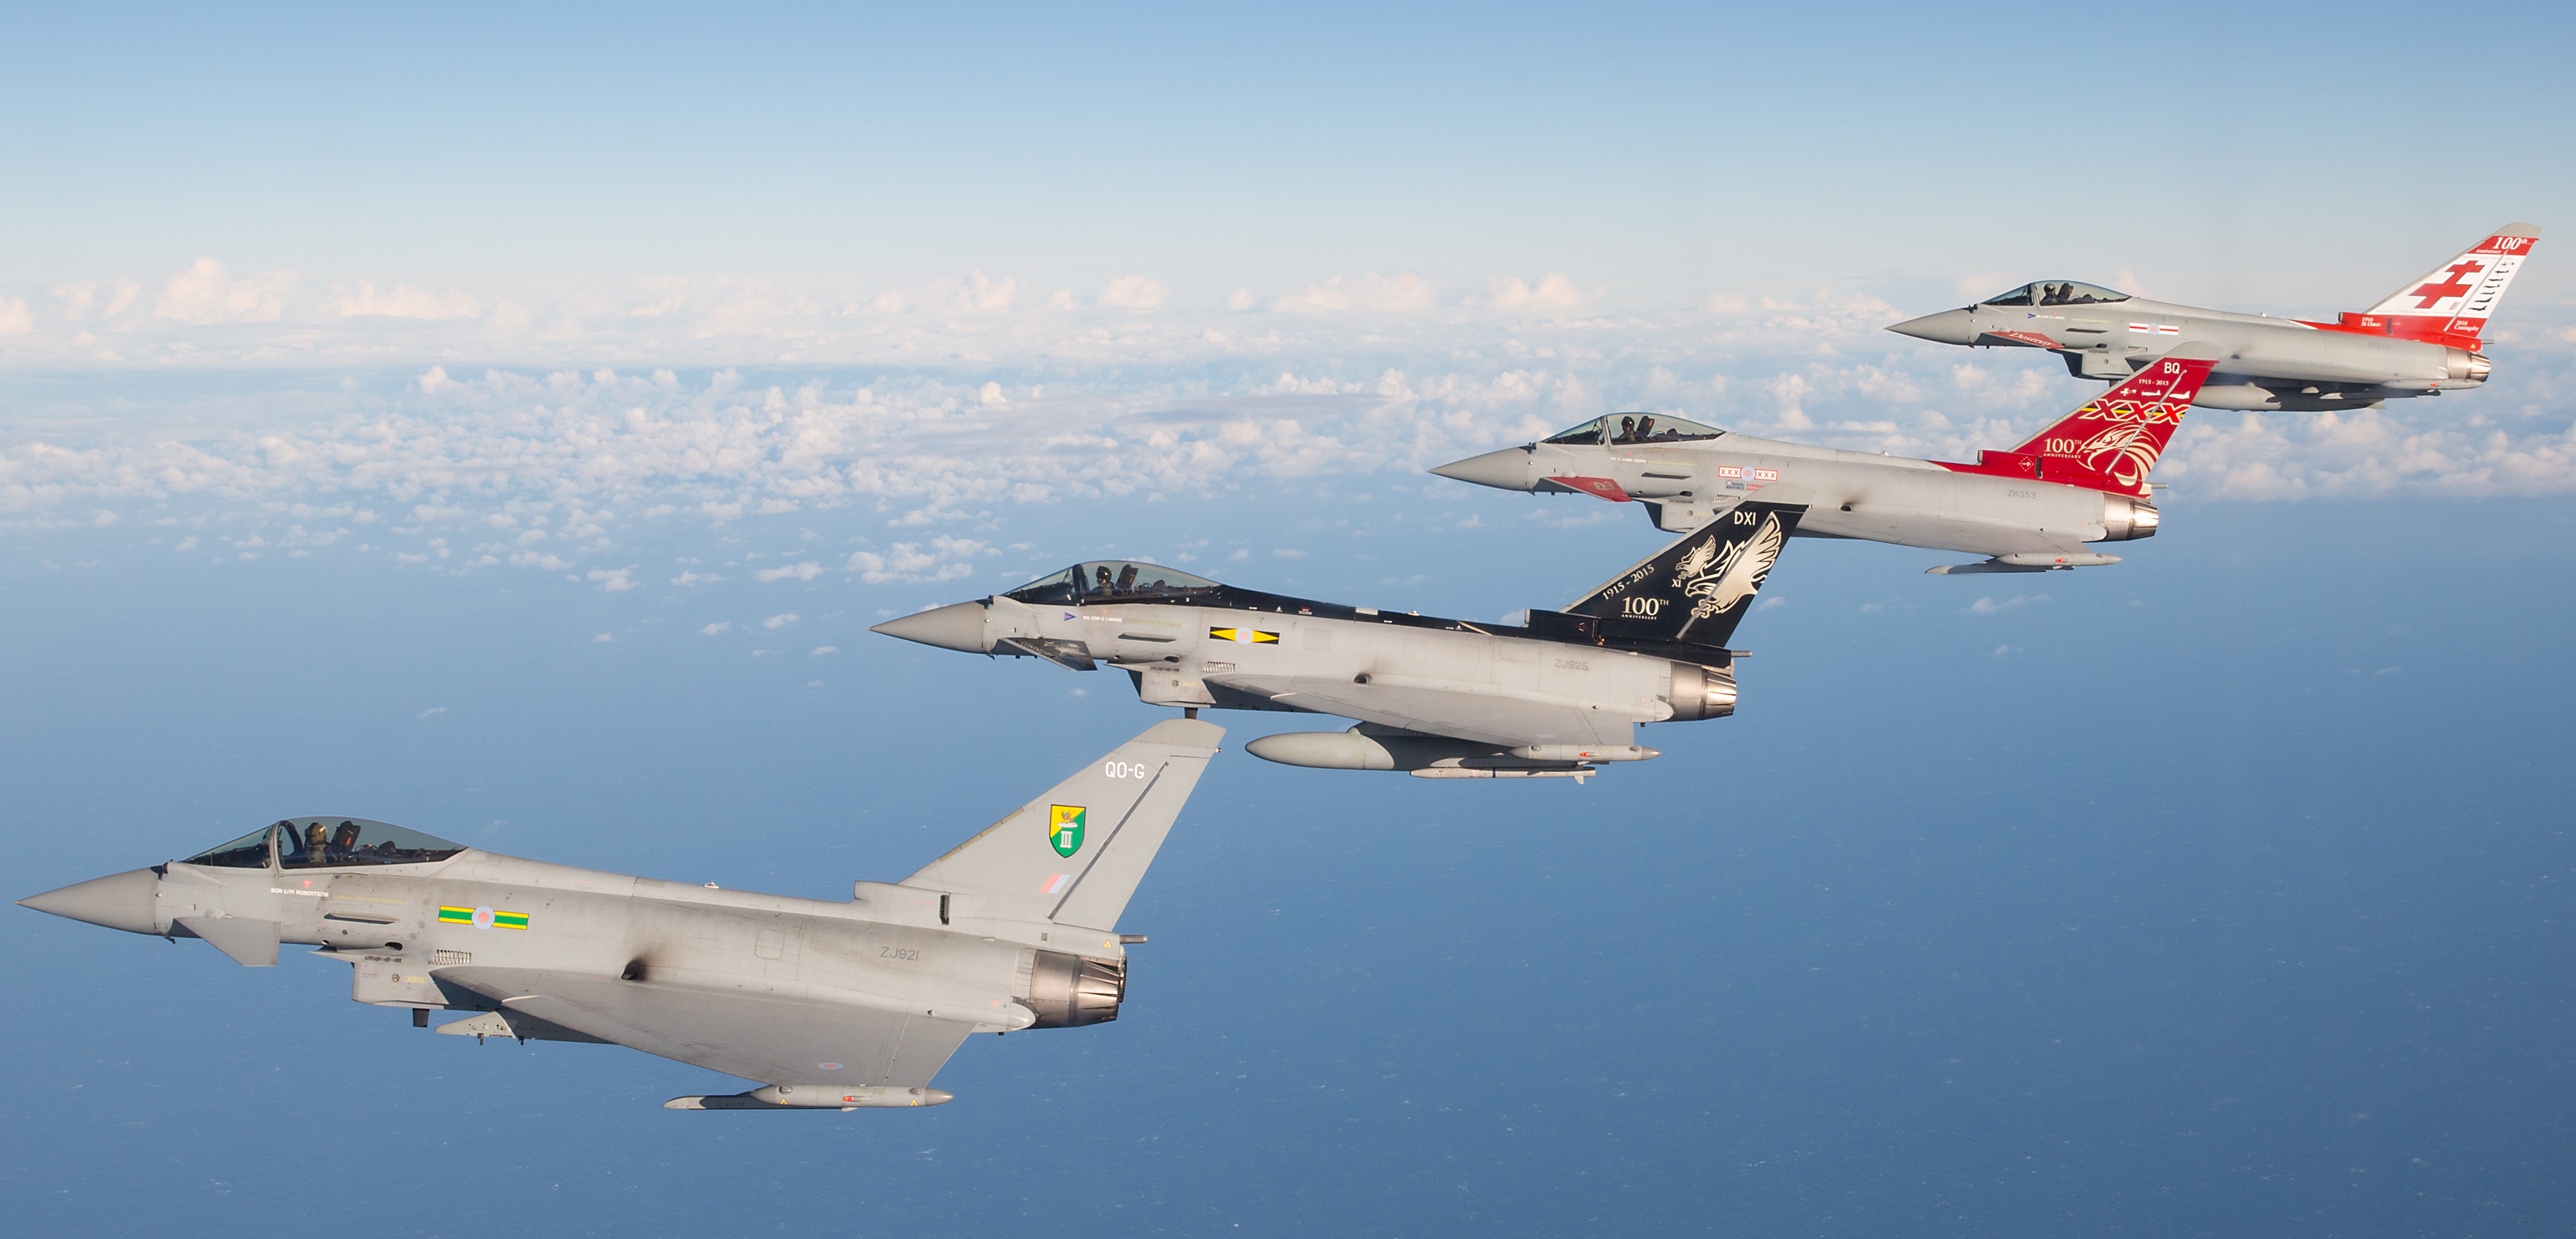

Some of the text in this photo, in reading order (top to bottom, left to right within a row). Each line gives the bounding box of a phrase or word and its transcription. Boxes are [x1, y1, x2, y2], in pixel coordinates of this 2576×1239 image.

[2454, 324, 2480, 332] Coningsby
[2009, 333, 2056, 347] Destroy
[2164, 362, 2180, 374] BQ
[2007, 489, 2036, 499] ZK353
[1734, 512, 1755, 525] DXI
[1602, 581, 1625, 600] 1915
[1630, 564, 1655, 584] 2015
[1671, 578, 1681, 587] XI
[1554, 658, 1588, 671] ZJ925
[881, 946, 920, 961] ZJ921
